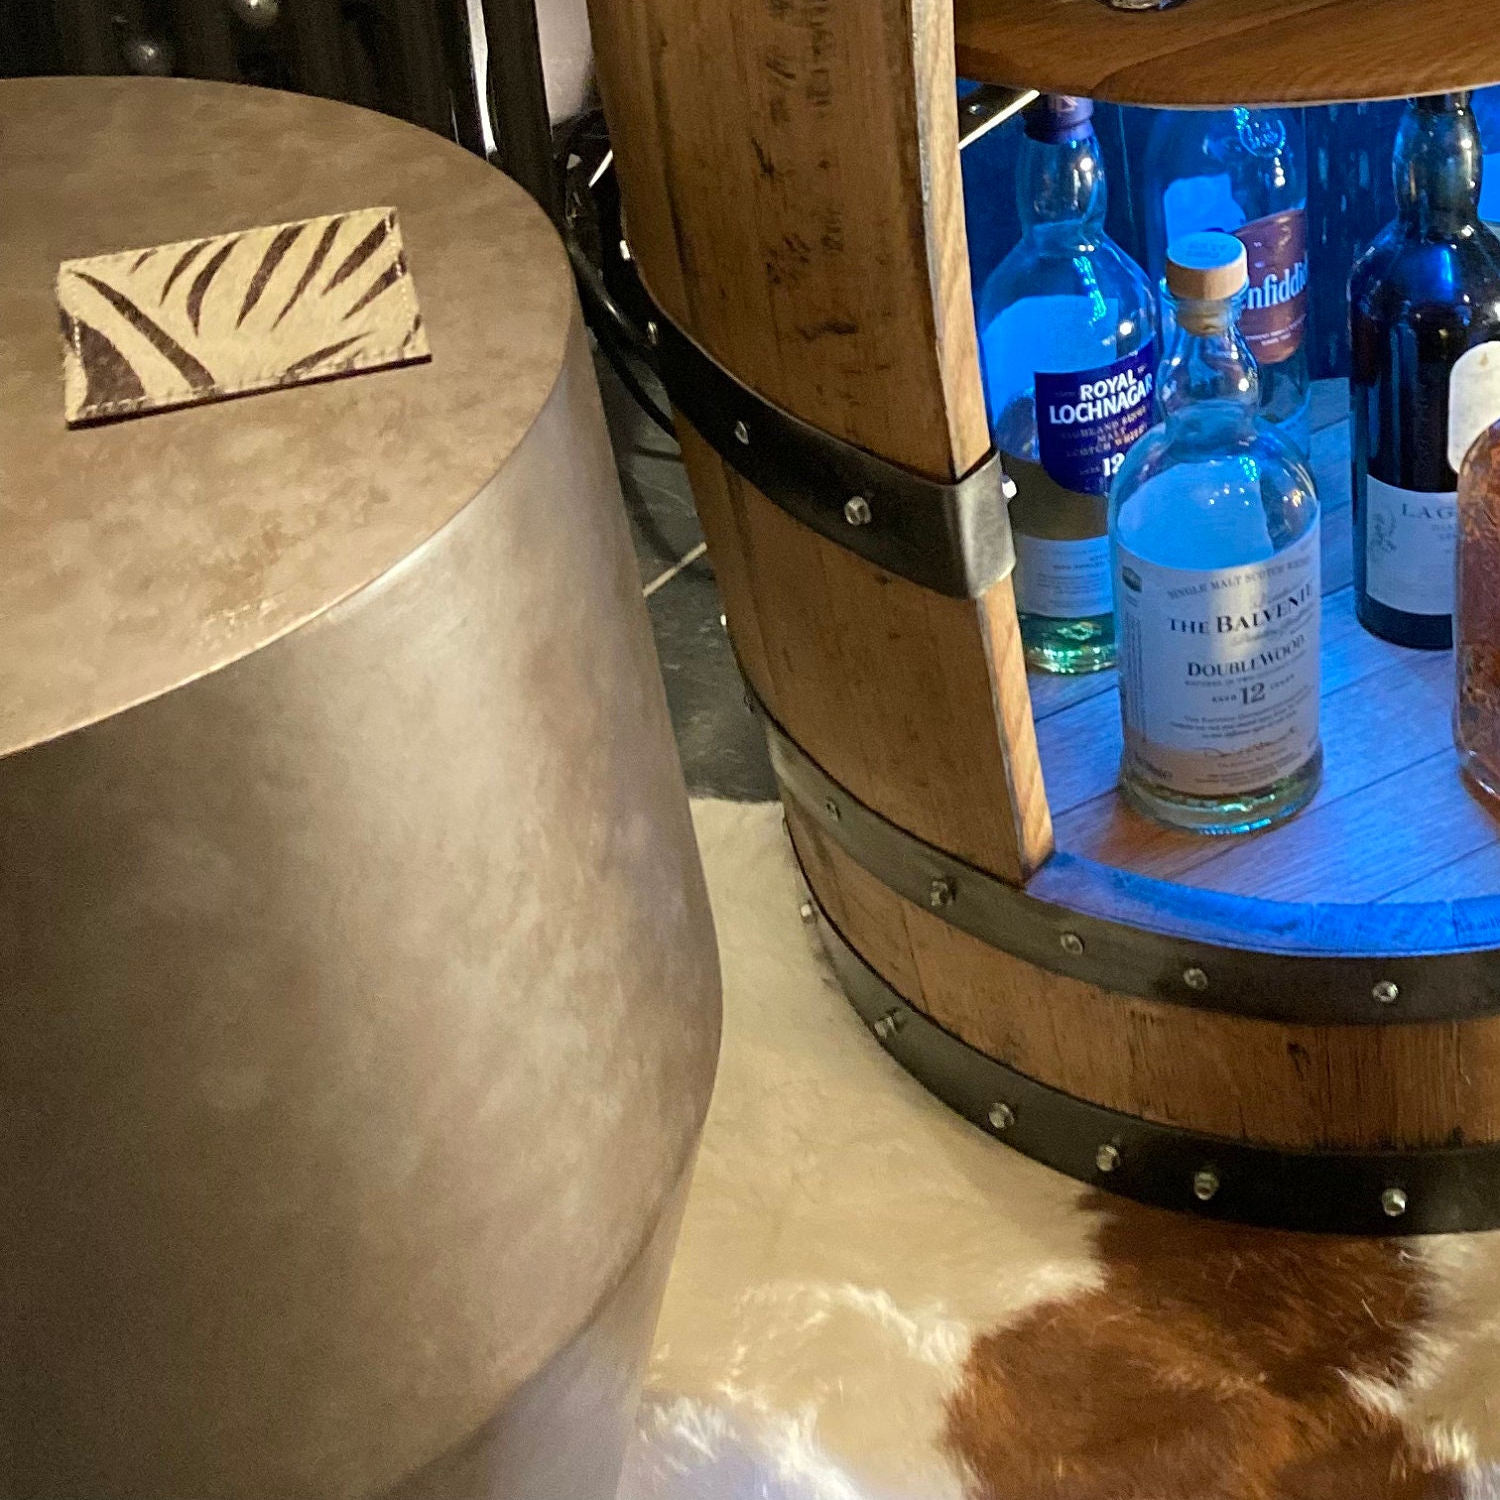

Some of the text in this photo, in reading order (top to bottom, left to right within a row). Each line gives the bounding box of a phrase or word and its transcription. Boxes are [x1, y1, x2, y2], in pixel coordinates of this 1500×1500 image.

[1048, 372, 1153, 425] LOCHNAGAR
[1080, 368, 1138, 401] ROYAL
[1102, 452, 1126, 477] 12
[1169, 616, 1211, 635] THE
[1216, 580, 1314, 634] BALVENIE
[1240, 681, 1266, 706] 12
